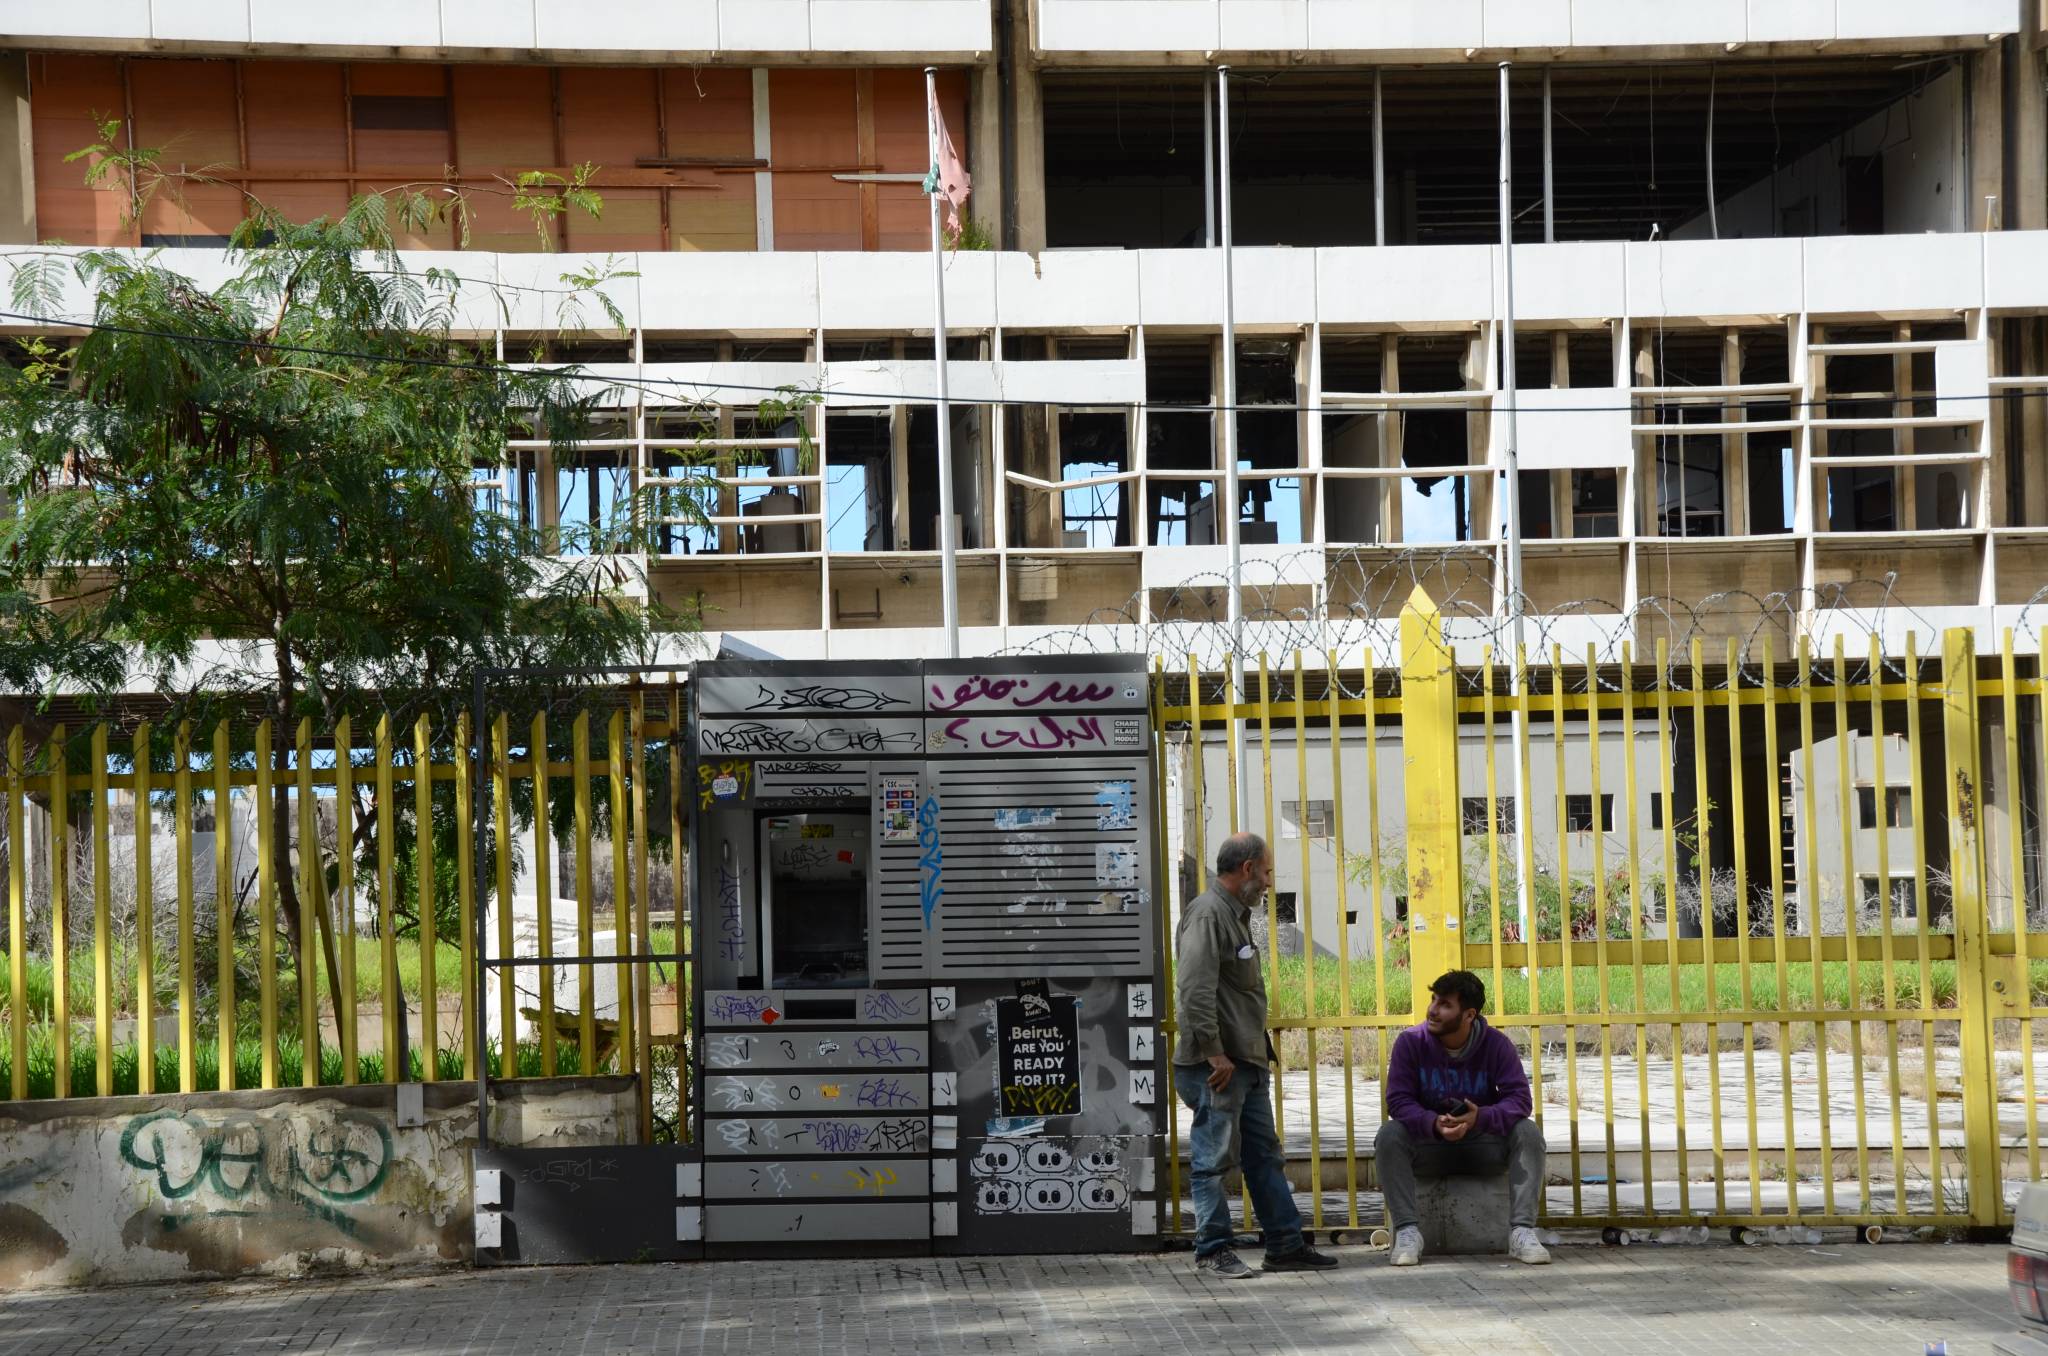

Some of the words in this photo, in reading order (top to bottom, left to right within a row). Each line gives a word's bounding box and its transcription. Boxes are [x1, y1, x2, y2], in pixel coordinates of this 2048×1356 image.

[1132, 991, 1147, 1012] $
[1011, 1026, 1063, 1040] Beirut,
[1013, 1043, 1036, 1054] ARE
[1038, 1042, 1064, 1053] YOU
[1014, 1057, 1064, 1071] READY
[1014, 1075, 1042, 1087] FOR
[1046, 1073, 1066, 1086] IT?
